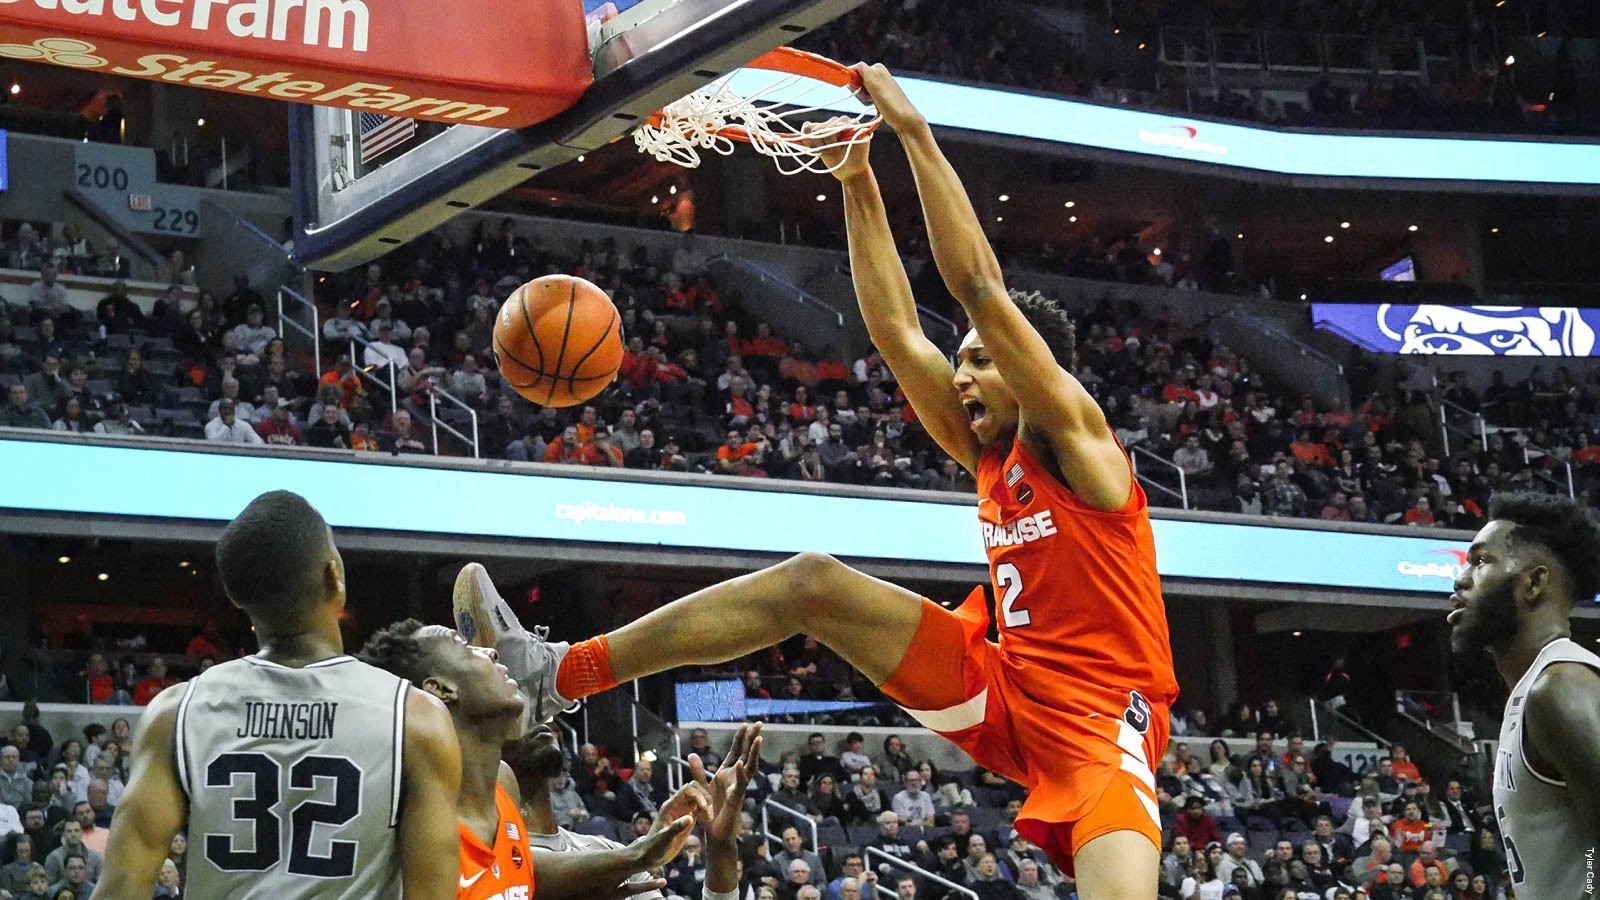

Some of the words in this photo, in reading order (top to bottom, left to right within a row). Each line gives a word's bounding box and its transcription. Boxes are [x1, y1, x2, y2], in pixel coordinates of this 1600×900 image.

[78, 163, 129, 191] 200
[153, 207, 199, 233] 229
[996, 562, 1031, 628] 2
[237, 701, 338, 740] JOHNSON
[204, 751, 364, 880] 32
